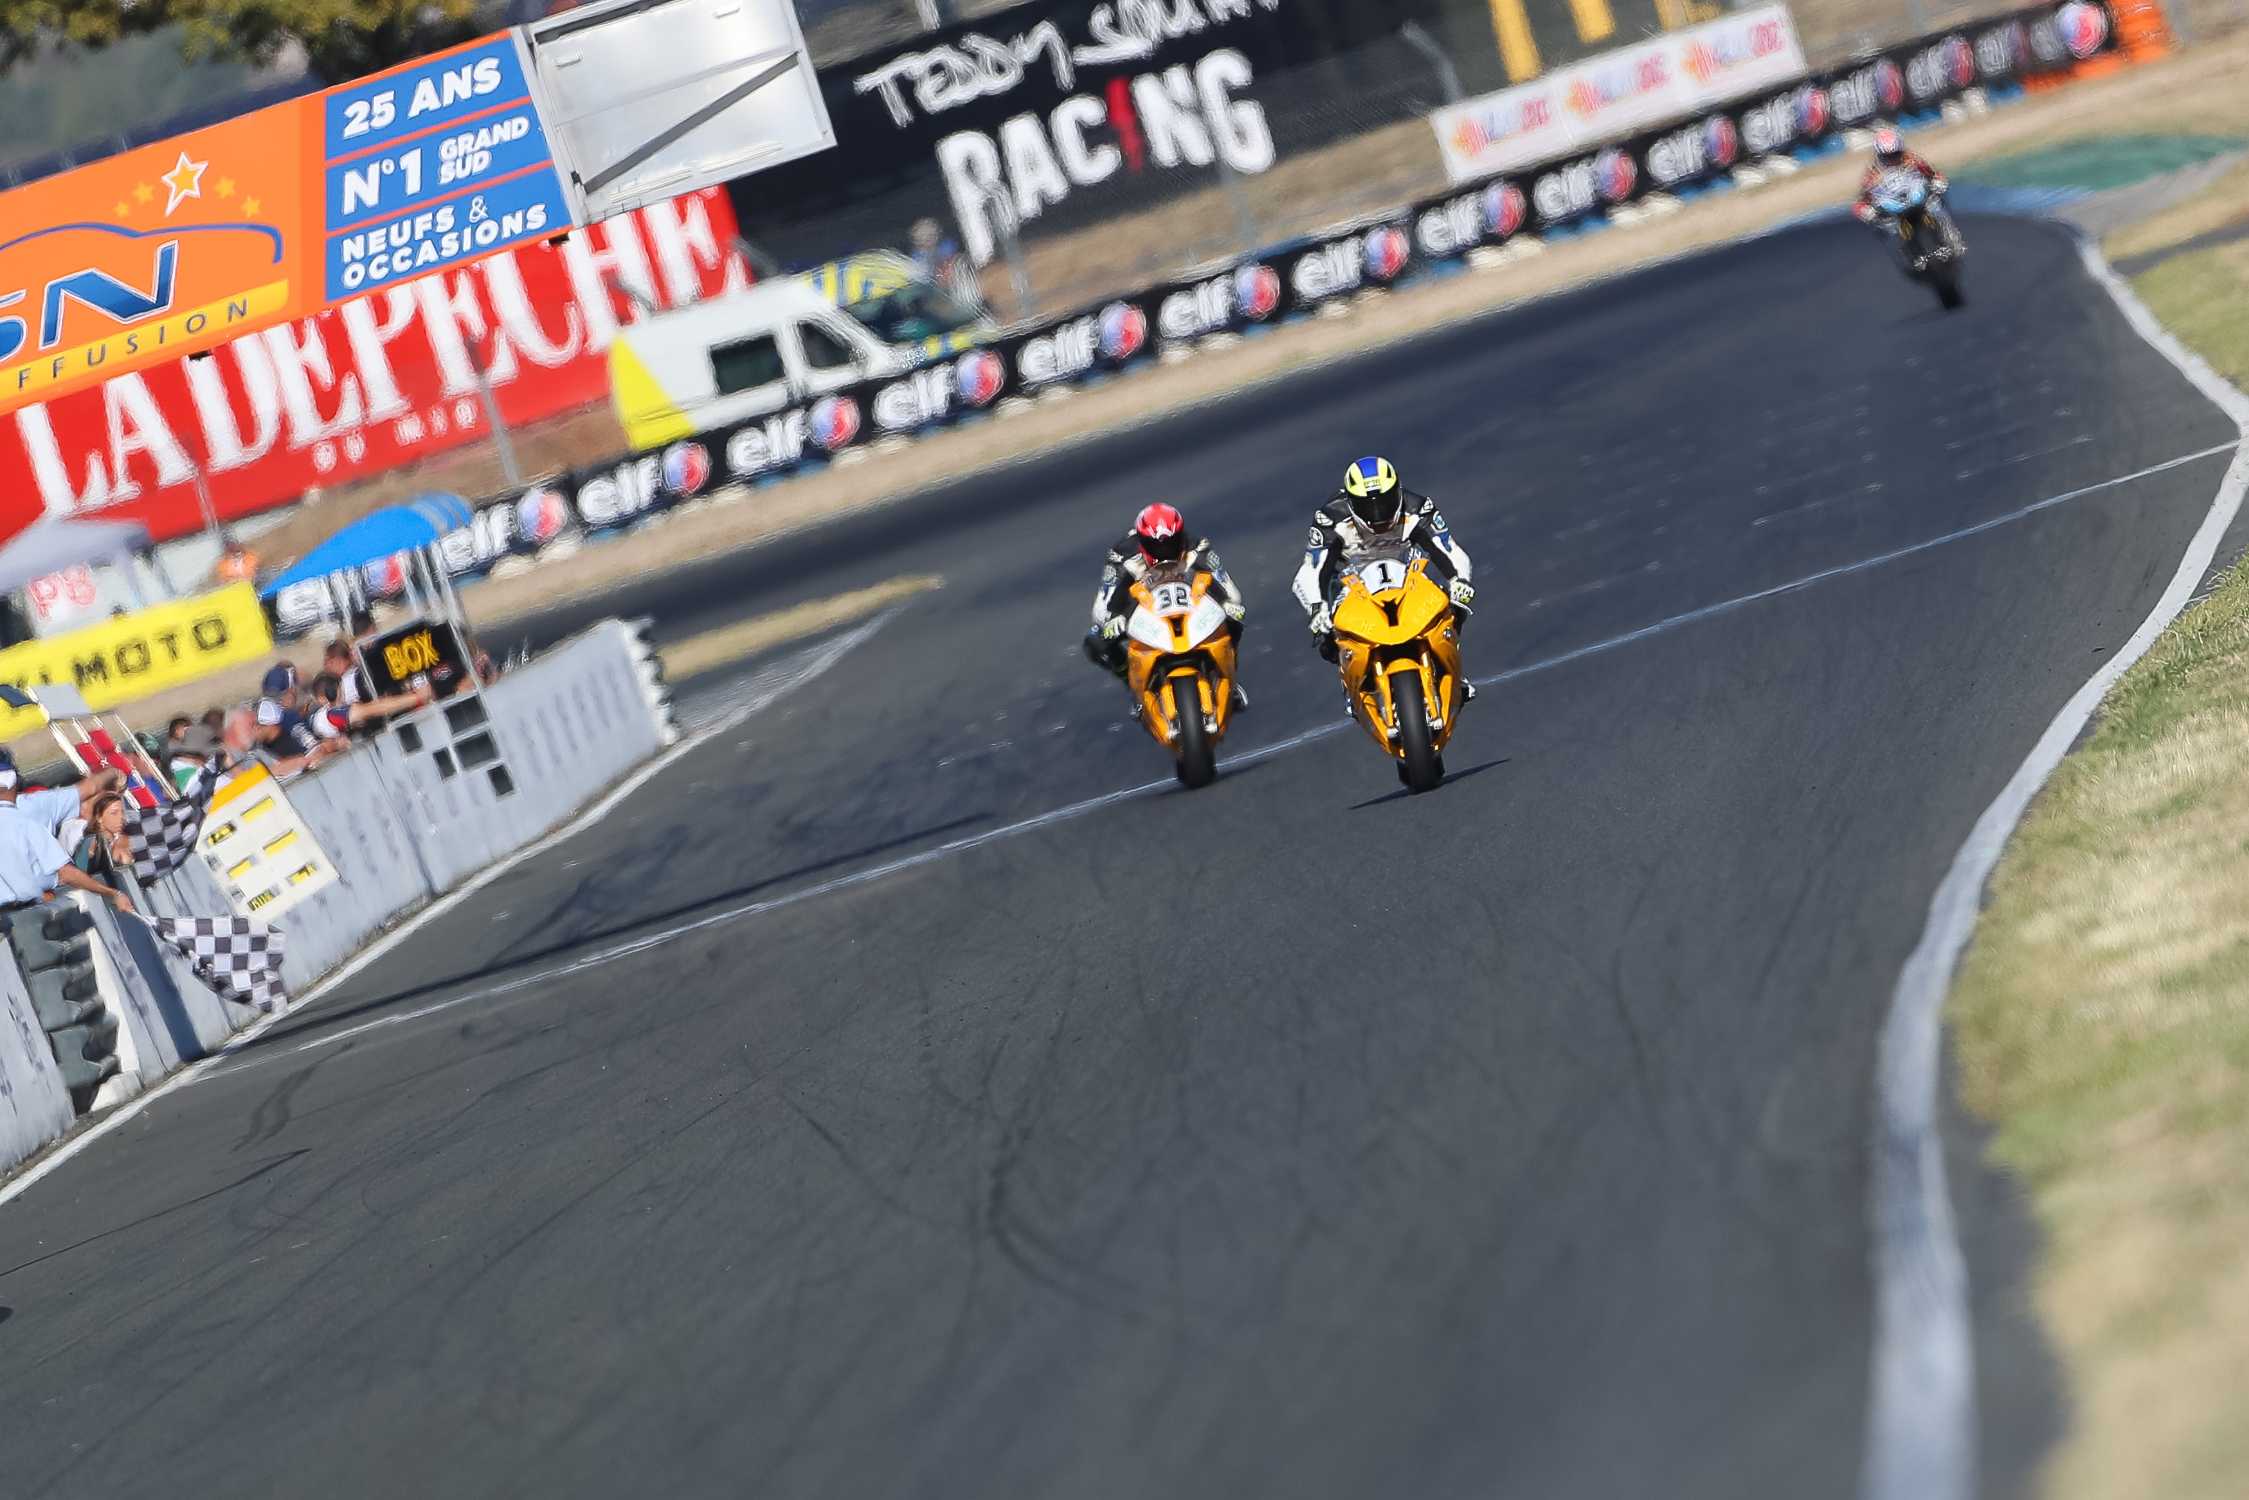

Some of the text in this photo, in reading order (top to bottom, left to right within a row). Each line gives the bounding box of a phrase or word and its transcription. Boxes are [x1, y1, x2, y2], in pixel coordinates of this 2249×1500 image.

[343, 57, 502, 139] 25 ANS
[438, 150, 492, 185] SUD
[439, 116, 529, 160] GRAND
[935, 48, 1276, 270] RACING
[343, 195, 488, 263] NEUFS &
[343, 203, 548, 289] OCCASIONS
[577, 457, 661, 524] elf
[727, 408, 805, 472] elf
[873, 363, 954, 429] elf
[1158, 585, 1189, 609] 32
[1376, 563, 1392, 585] 1
[72, 615, 228, 689] MOTO
[384, 629, 440, 681] BOX
